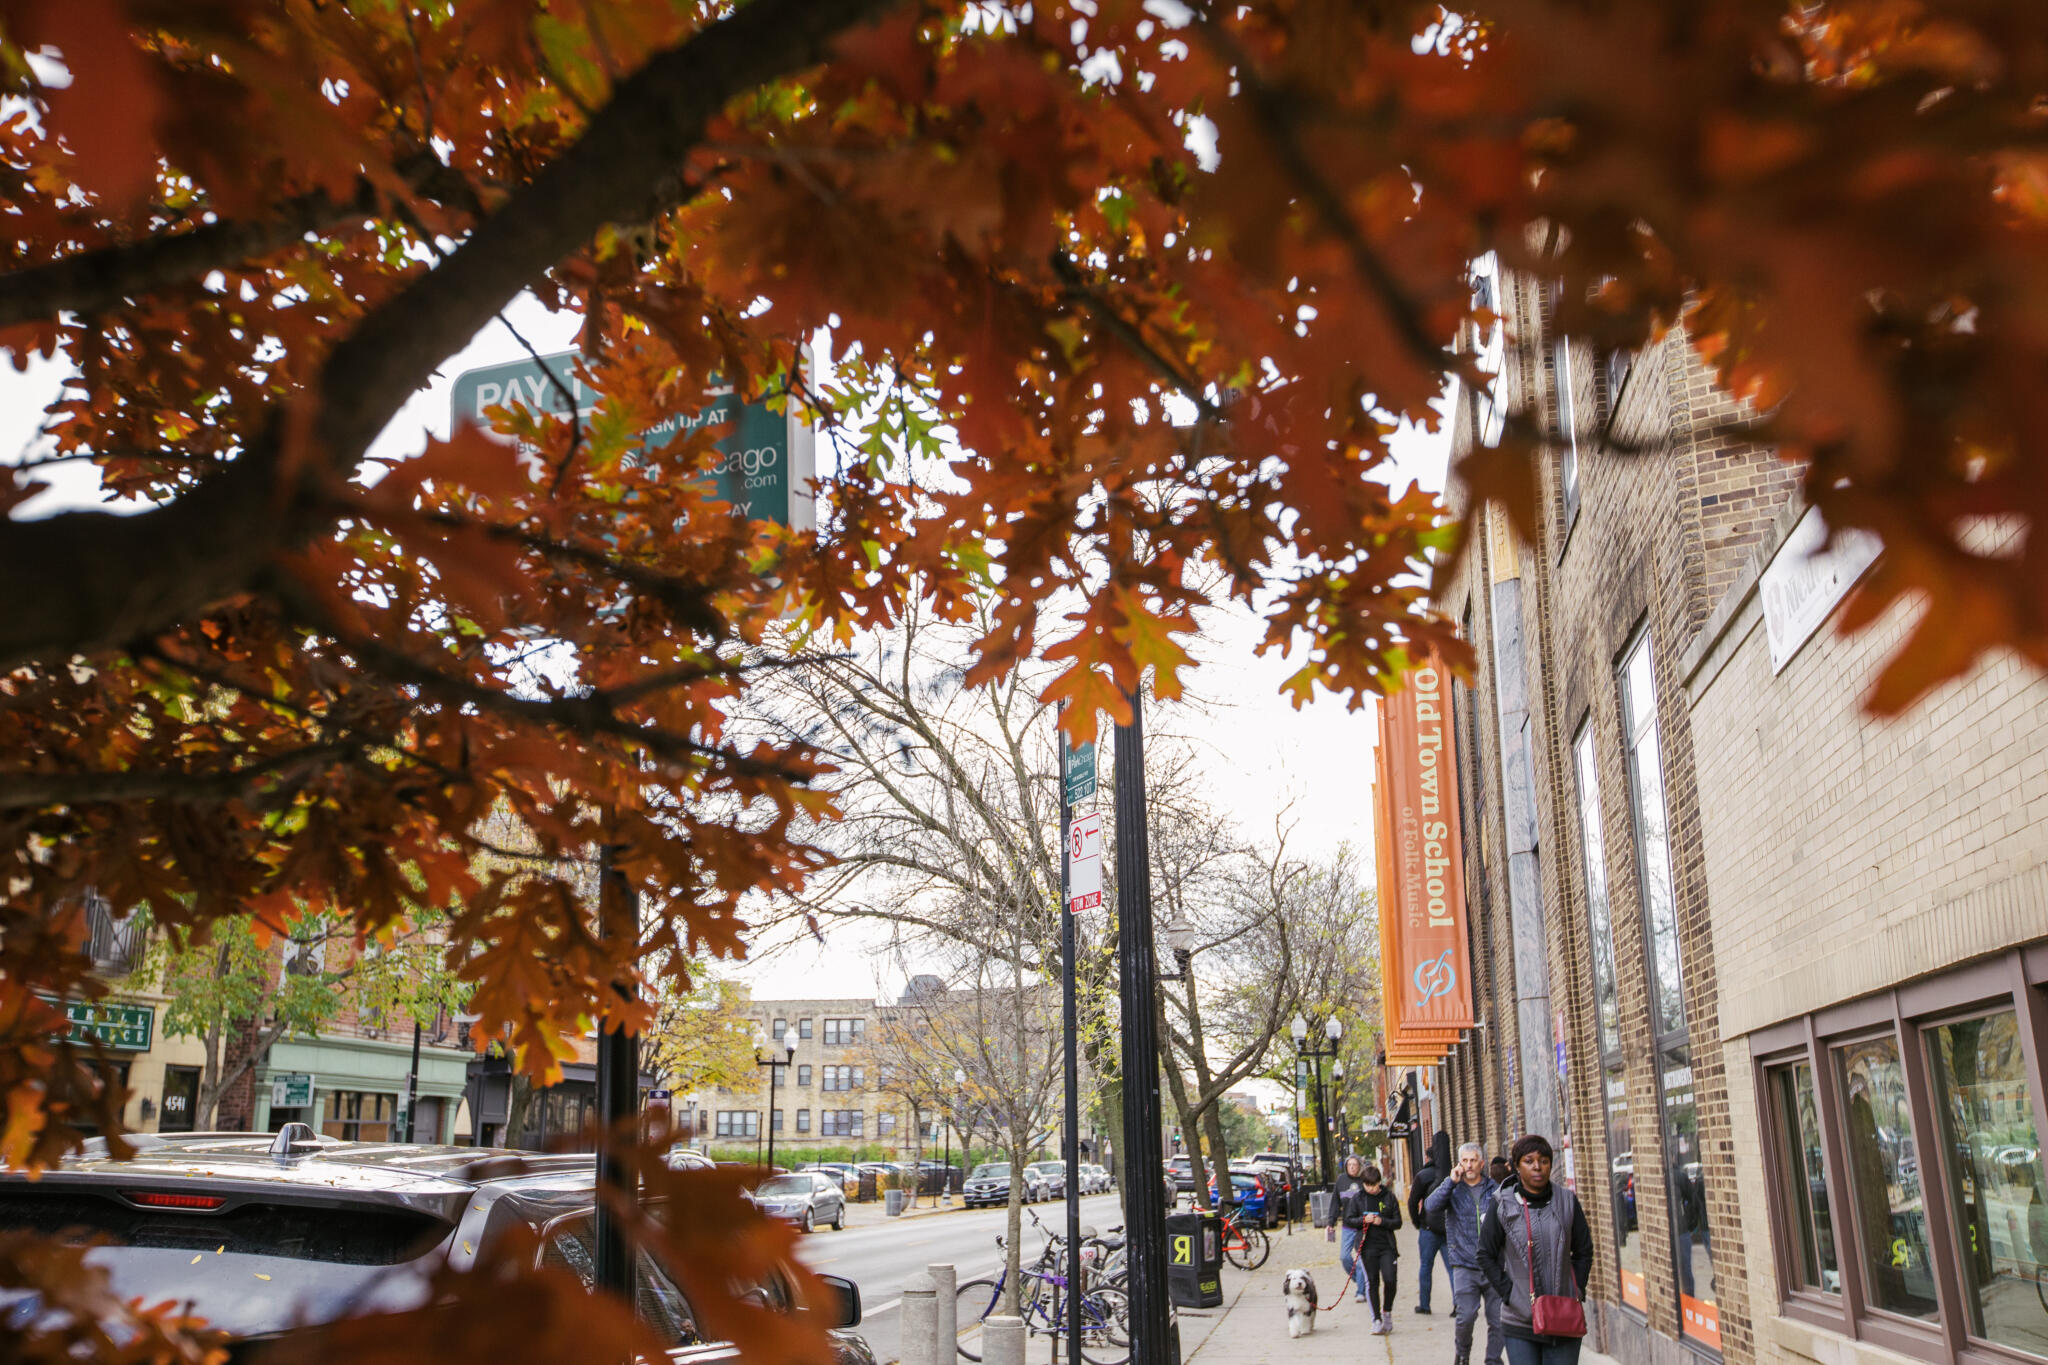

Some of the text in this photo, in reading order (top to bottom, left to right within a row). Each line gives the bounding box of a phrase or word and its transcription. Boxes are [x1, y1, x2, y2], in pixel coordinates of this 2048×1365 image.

[476, 374, 549, 419] PAY
[707, 409, 728, 425] AT
[1414, 667, 1455, 928] Old Town School
[1402, 806, 1424, 928] of Folk Music
[1085, 892, 1098, 907] ZONE
[165, 1095, 186, 1112] 4541
